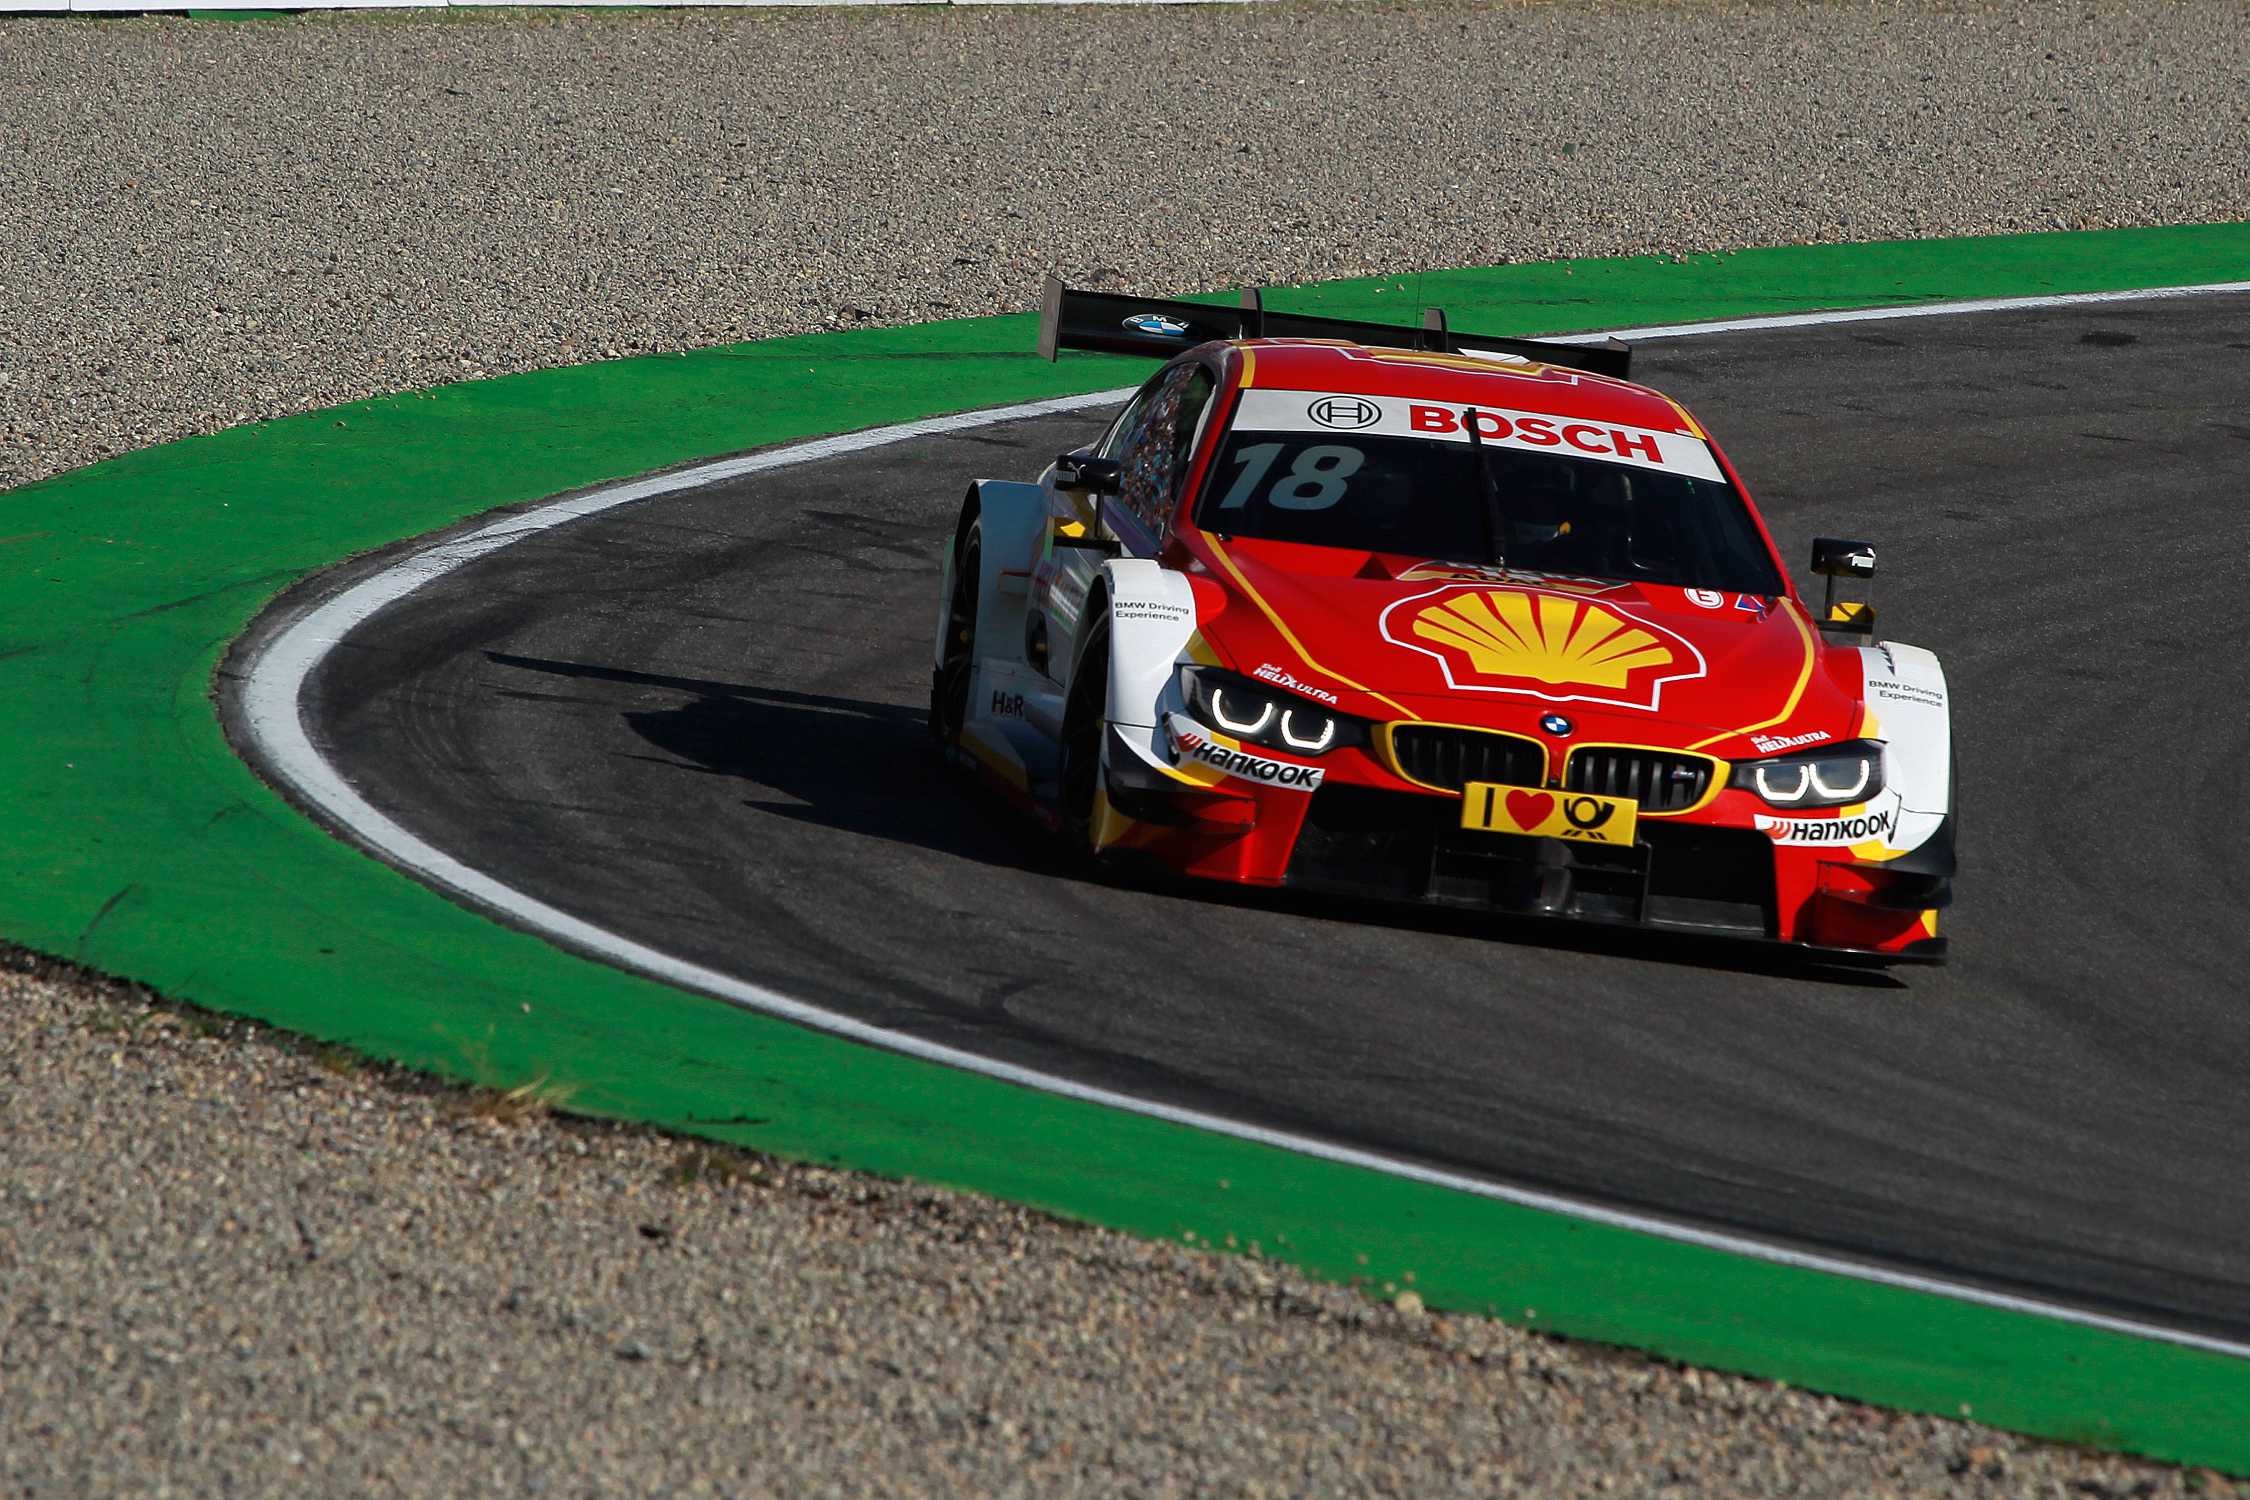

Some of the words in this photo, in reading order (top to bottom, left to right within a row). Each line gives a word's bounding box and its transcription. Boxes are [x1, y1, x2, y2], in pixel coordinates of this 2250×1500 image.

[1408, 404, 1665, 465] BOSCH
[1218, 442, 1366, 511] 18
[1115, 610, 1180, 621] Experience
[1148, 602, 1190, 615] Driving
[1869, 680, 1900, 689] BMW
[1902, 684, 1943, 700] Driving
[1879, 690, 1943, 708] Experience
[1482, 786, 1496, 828] I
